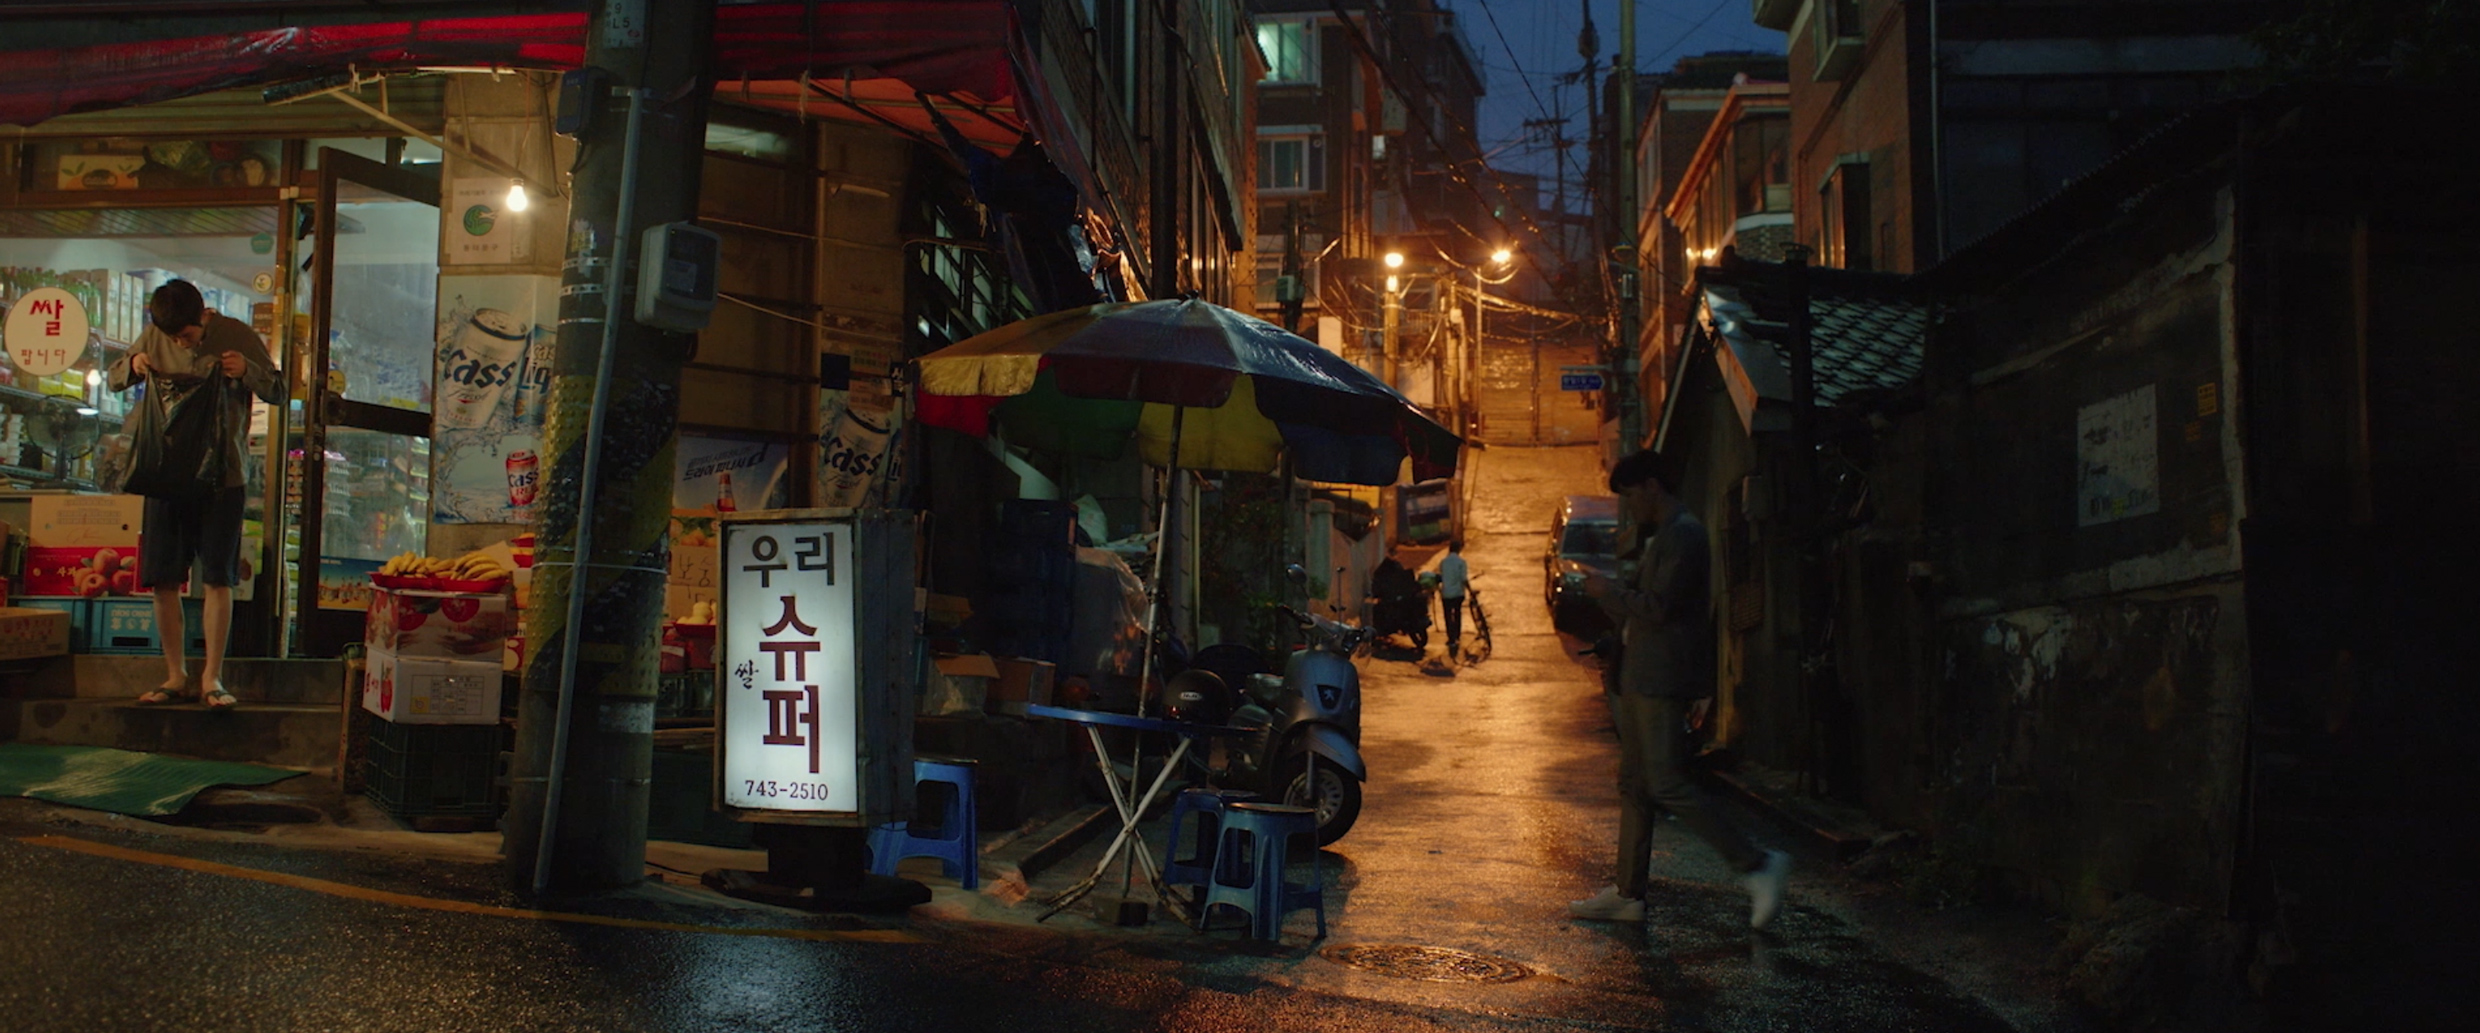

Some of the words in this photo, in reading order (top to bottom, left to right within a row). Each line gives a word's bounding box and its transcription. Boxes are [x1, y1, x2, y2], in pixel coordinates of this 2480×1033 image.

[30, 299, 64, 336] 쌀
[21, 349, 66, 366] 팝니다
[443, 349, 517, 389] Cass
[825, 437, 883, 476] Cass
[743, 532, 835, 587] 우리
[759, 596, 820, 773] 슈퍼
[744, 780, 829, 801] 743-2510
